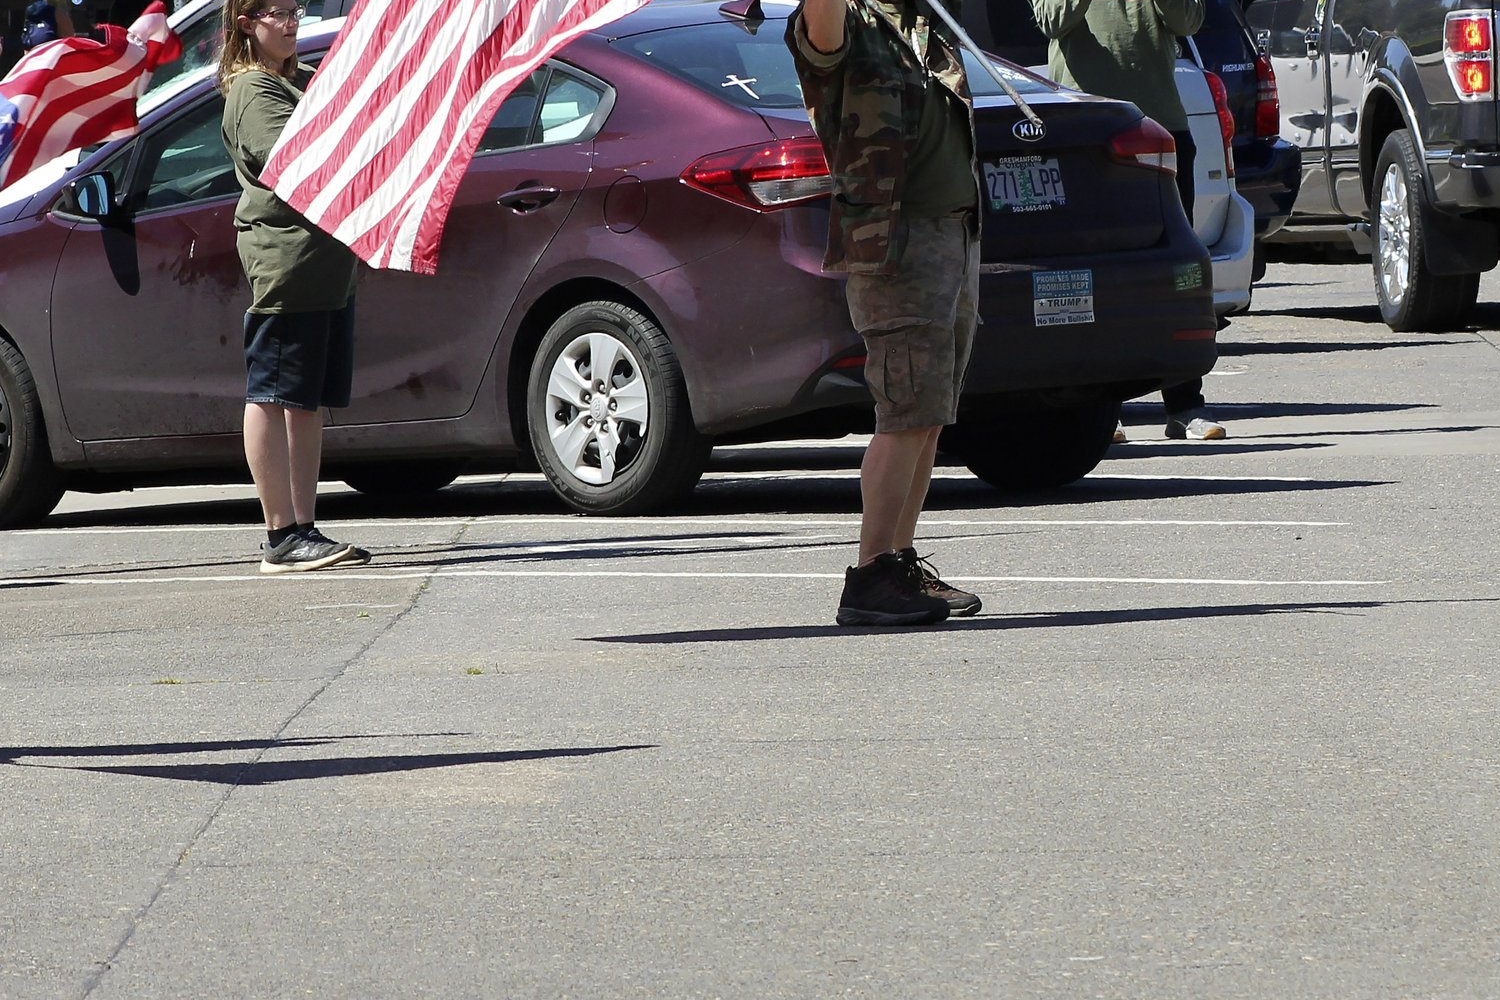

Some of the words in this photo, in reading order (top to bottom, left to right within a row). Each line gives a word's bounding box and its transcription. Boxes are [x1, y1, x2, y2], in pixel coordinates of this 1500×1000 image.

[987, 171, 1019, 199] 271
[1028, 168, 1061, 197] LPP
[1036, 274, 1069, 283] PROMISES
[1070, 273, 1089, 281] MADE
[1037, 283, 1071, 292] PROMISES
[1071, 282, 1089, 290] KEPT
[1047, 298, 1082, 307] TRUMP
[1037, 317, 1047, 325] No
[1049, 316, 1066, 324] More
[1067, 314, 1094, 323] Bullshit
